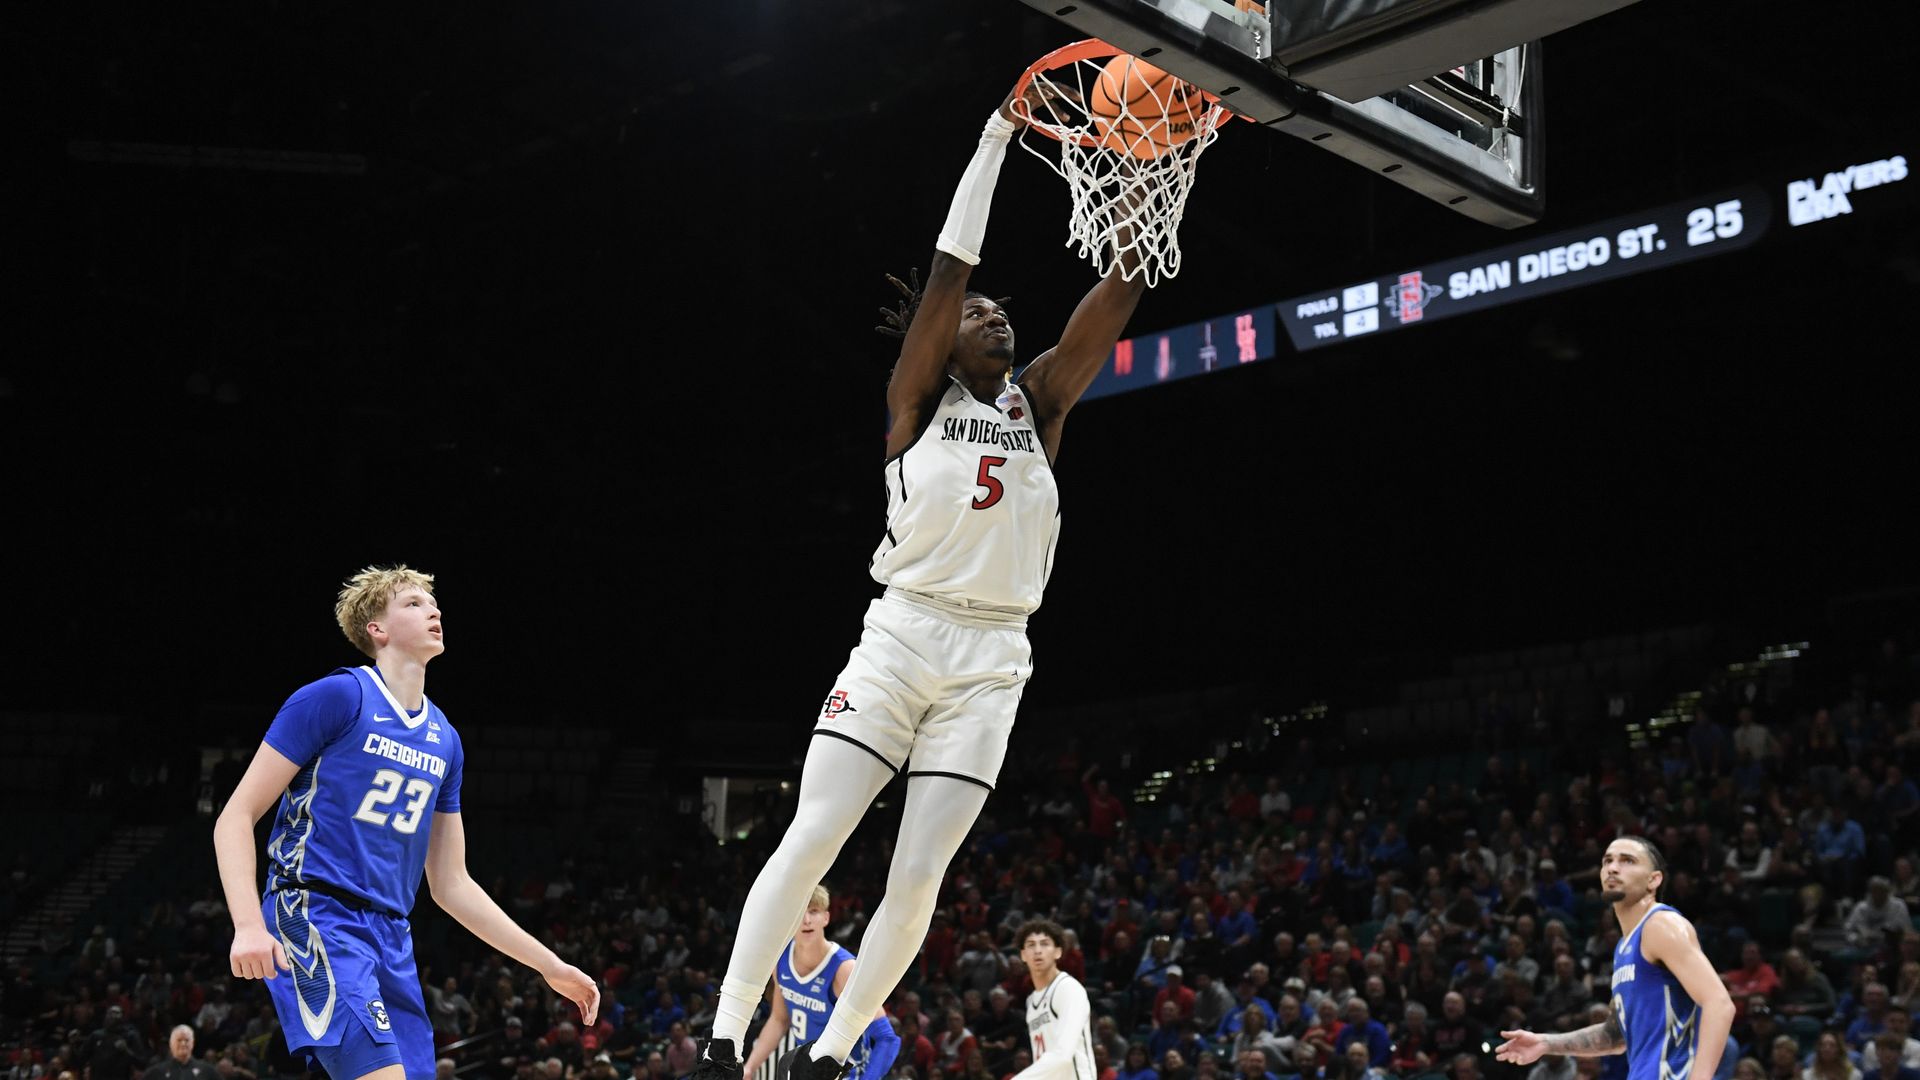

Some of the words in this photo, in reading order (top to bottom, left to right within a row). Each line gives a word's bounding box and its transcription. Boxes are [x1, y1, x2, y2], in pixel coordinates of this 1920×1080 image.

[1787, 155, 1908, 201] PLAYERS
[1788, 190, 1853, 226] ERA
[1449, 260, 1511, 300] SAN
[1518, 236, 1611, 284] DIEGO
[1617, 223, 1666, 259] ST.
[1686, 199, 1744, 247] 25
[1296, 296, 1339, 319] FOULS
[941, 417, 965, 441] SAN
[968, 418, 1001, 445] DIEG
[971, 455, 1008, 511] 5
[362, 733, 447, 780] CREIGHTON
[352, 769, 435, 835] 23
[791, 1008, 808, 1040] 9
